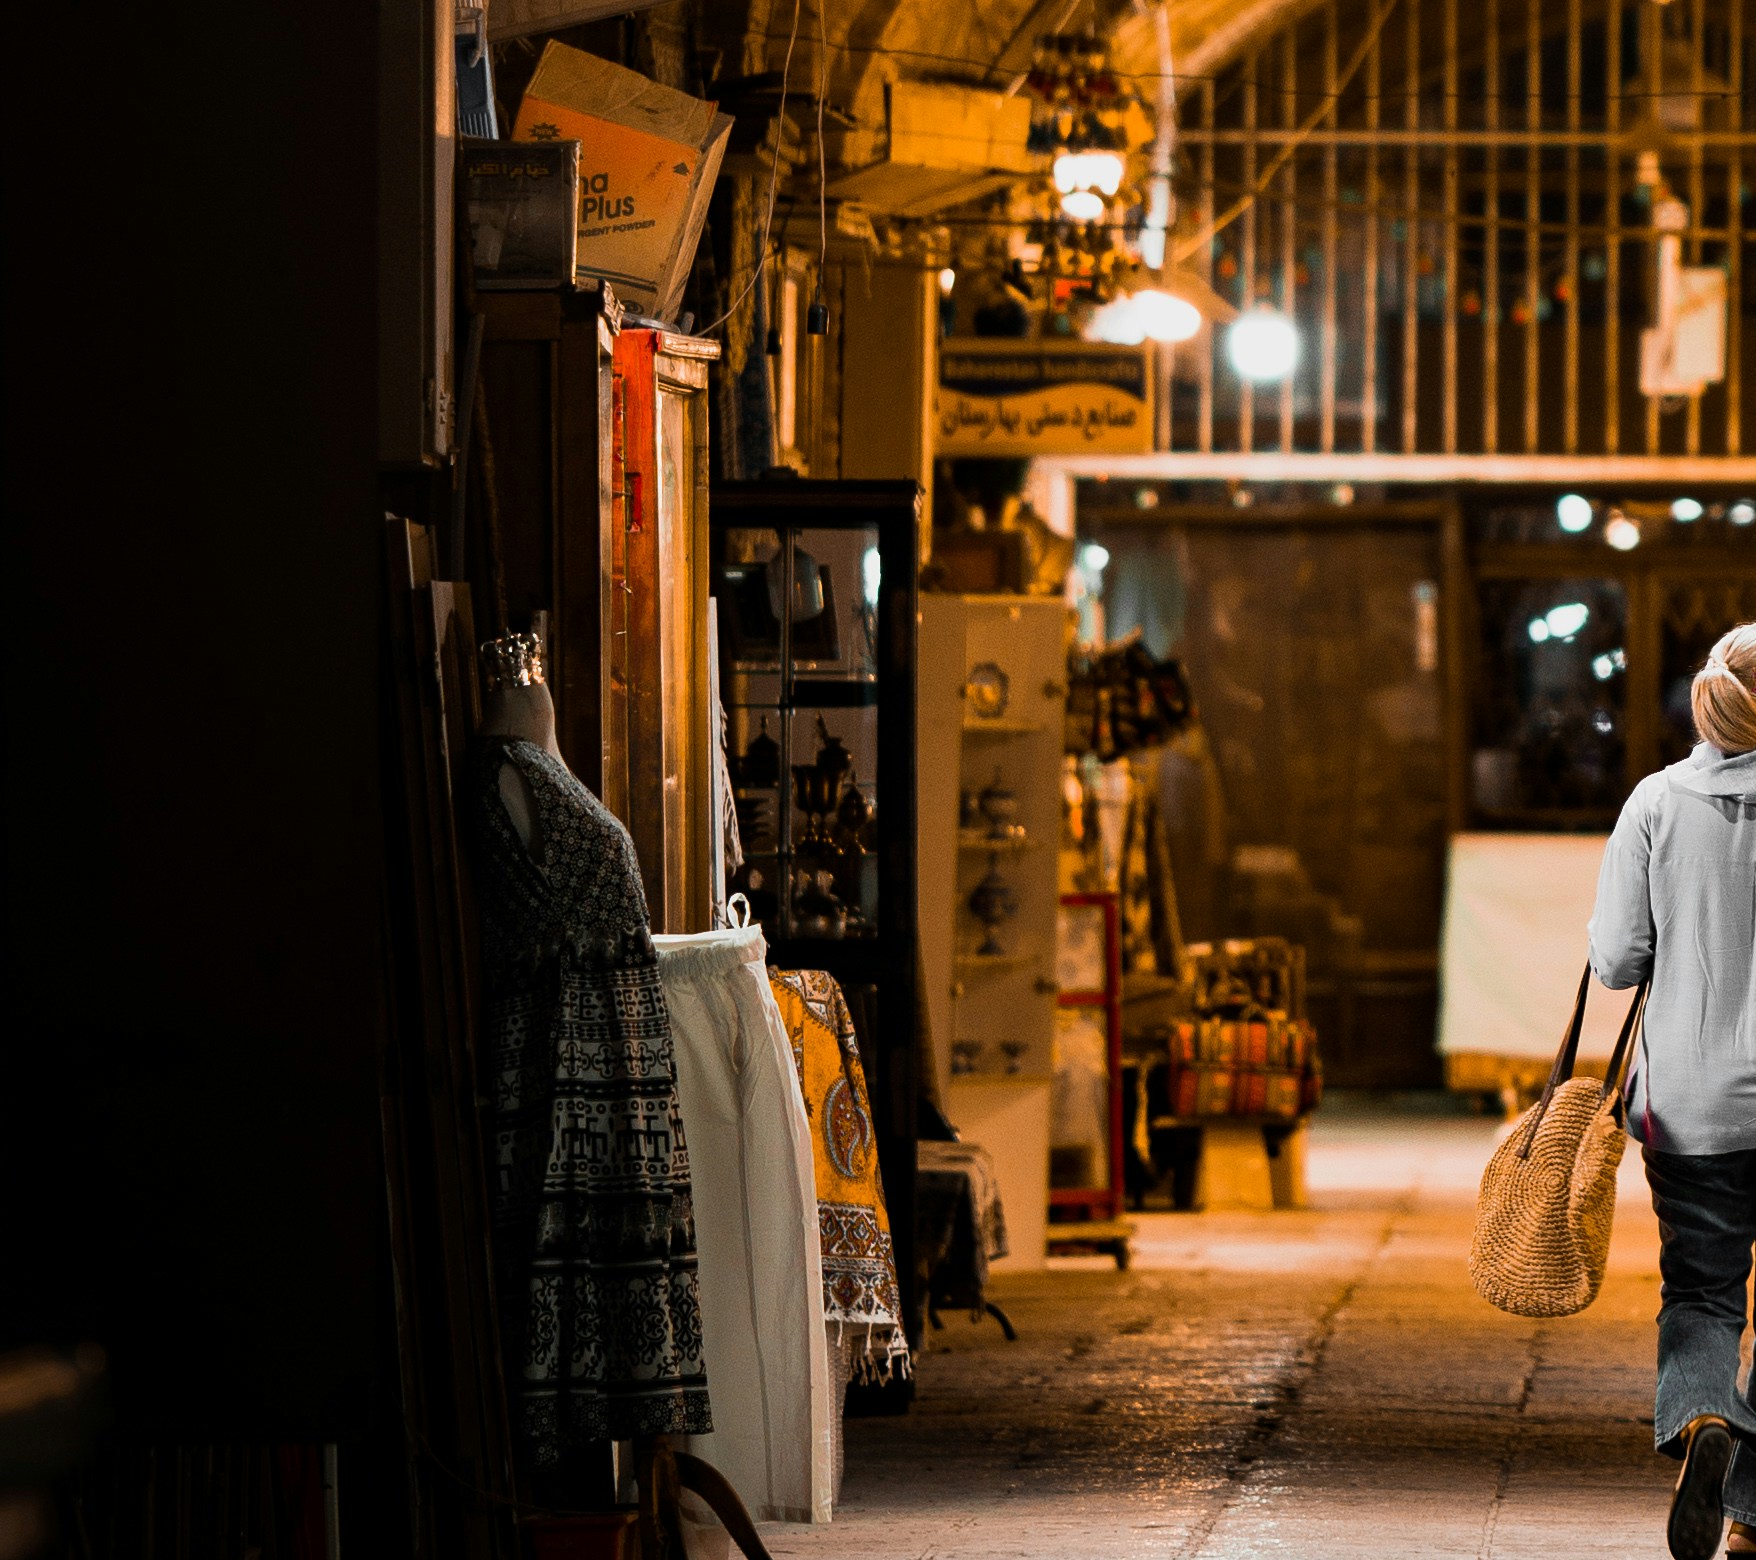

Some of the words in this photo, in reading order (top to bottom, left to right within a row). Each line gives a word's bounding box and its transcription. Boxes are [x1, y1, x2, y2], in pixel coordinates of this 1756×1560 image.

[582, 195, 635, 224] Plus
[577, 226, 612, 238] RGENT
[612, 219, 656, 233] POWDER
